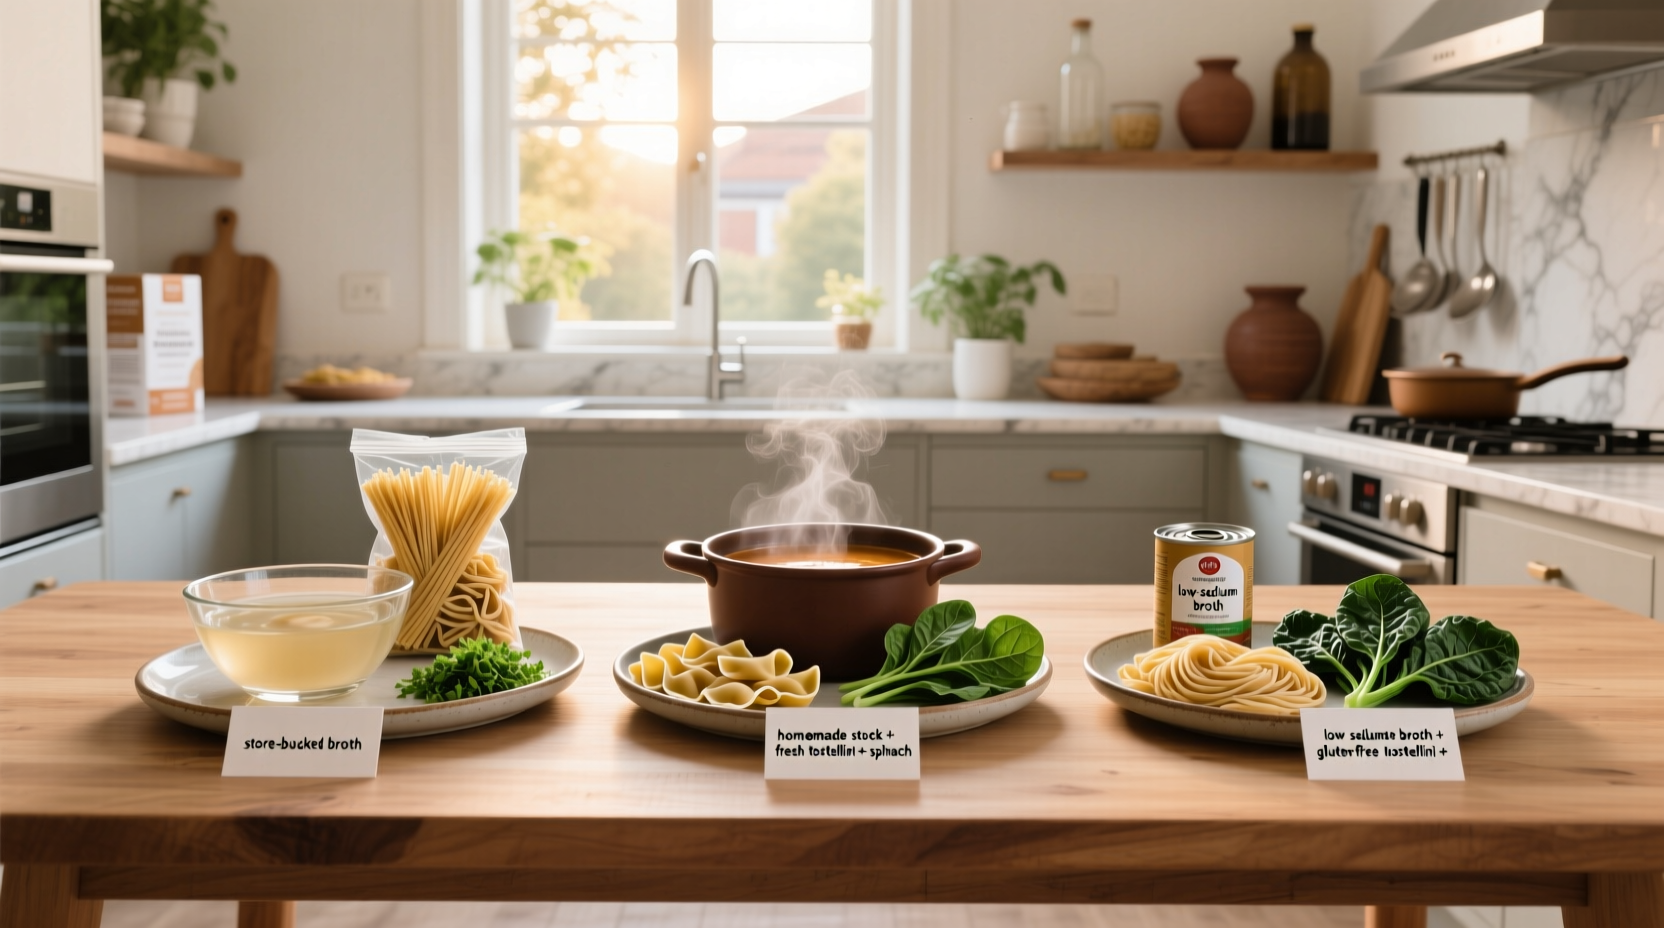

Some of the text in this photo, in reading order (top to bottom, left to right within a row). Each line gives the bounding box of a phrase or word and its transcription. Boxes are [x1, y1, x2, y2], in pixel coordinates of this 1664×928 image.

[1193, 599, 1224, 612] broth
[851, 728, 883, 741] stock
[1324, 728, 1345, 741] low
[1399, 728, 1433, 741] broth
[327, 736, 362, 750] broth
[775, 744, 805, 757] fresh
